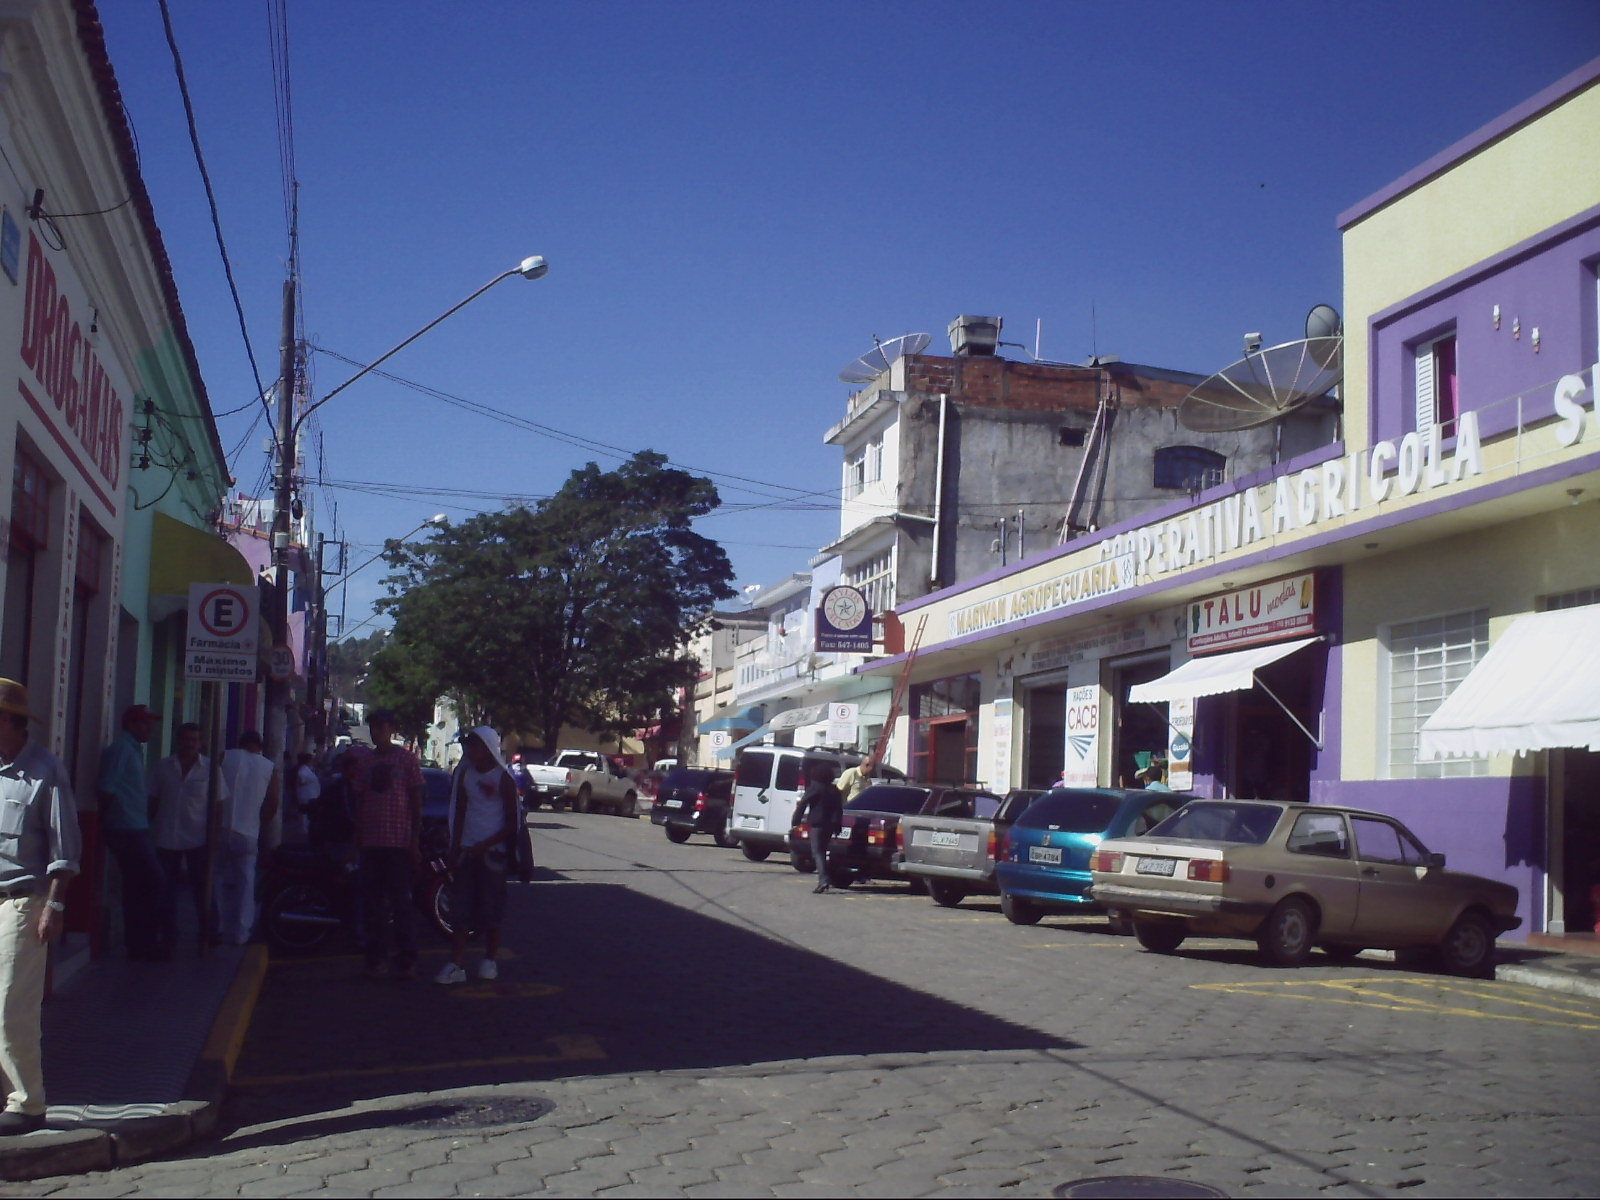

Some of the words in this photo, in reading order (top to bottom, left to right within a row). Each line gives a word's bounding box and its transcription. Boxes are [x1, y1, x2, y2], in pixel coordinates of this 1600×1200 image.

[20, 227, 123, 491] DROGAMAIS
[1100, 487, 1266, 576] COOPERATIVA
[1273, 410, 1483, 535] AGRICOLA
[214, 598, 233, 628] E
[1010, 560, 1119, 621] AGROPECUARIA
[1204, 589, 1261, 628] TALU
[1266, 582, 1296, 615] modas
[188, 664, 202, 674] 10
[206, 665, 253, 676] minutos
[1068, 704, 1098, 730] CACB
